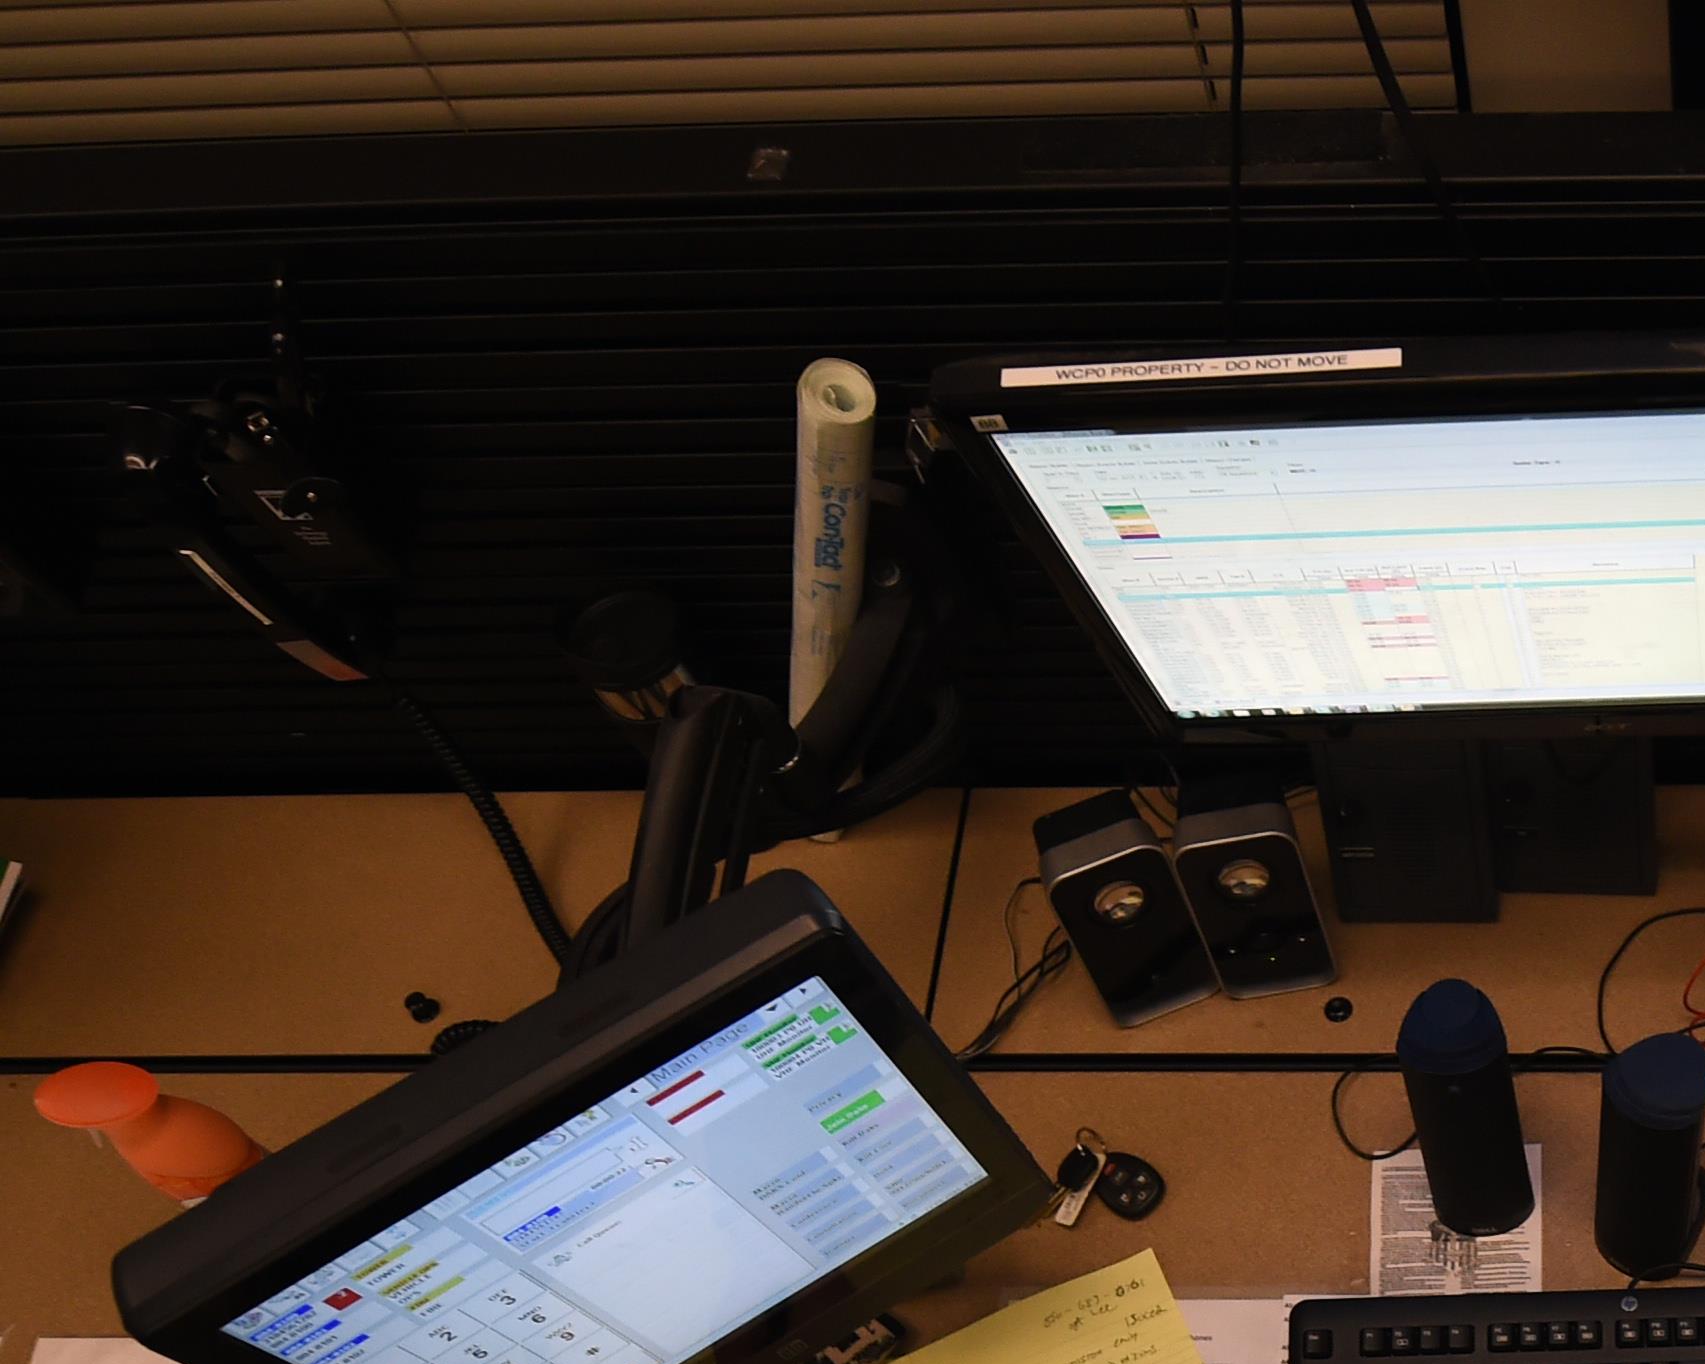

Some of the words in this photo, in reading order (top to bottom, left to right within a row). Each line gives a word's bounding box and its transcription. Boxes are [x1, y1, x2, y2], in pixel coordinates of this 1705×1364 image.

[1111, 363, 1204, 377] PROPERTY
[1225, 359, 1251, 372] DO
[1255, 358, 1292, 370] NOT
[1297, 355, 1348, 367] MOVE
[652, 1052, 698, 1083] Main
[699, 1022, 750, 1053] Page
[497, 1293, 518, 1306] 3
[528, 1312, 548, 1324] 6
[437, 1330, 458, 1342] 2
[558, 1330, 577, 1342] 9
[469, 1347, 490, 1360] 5
